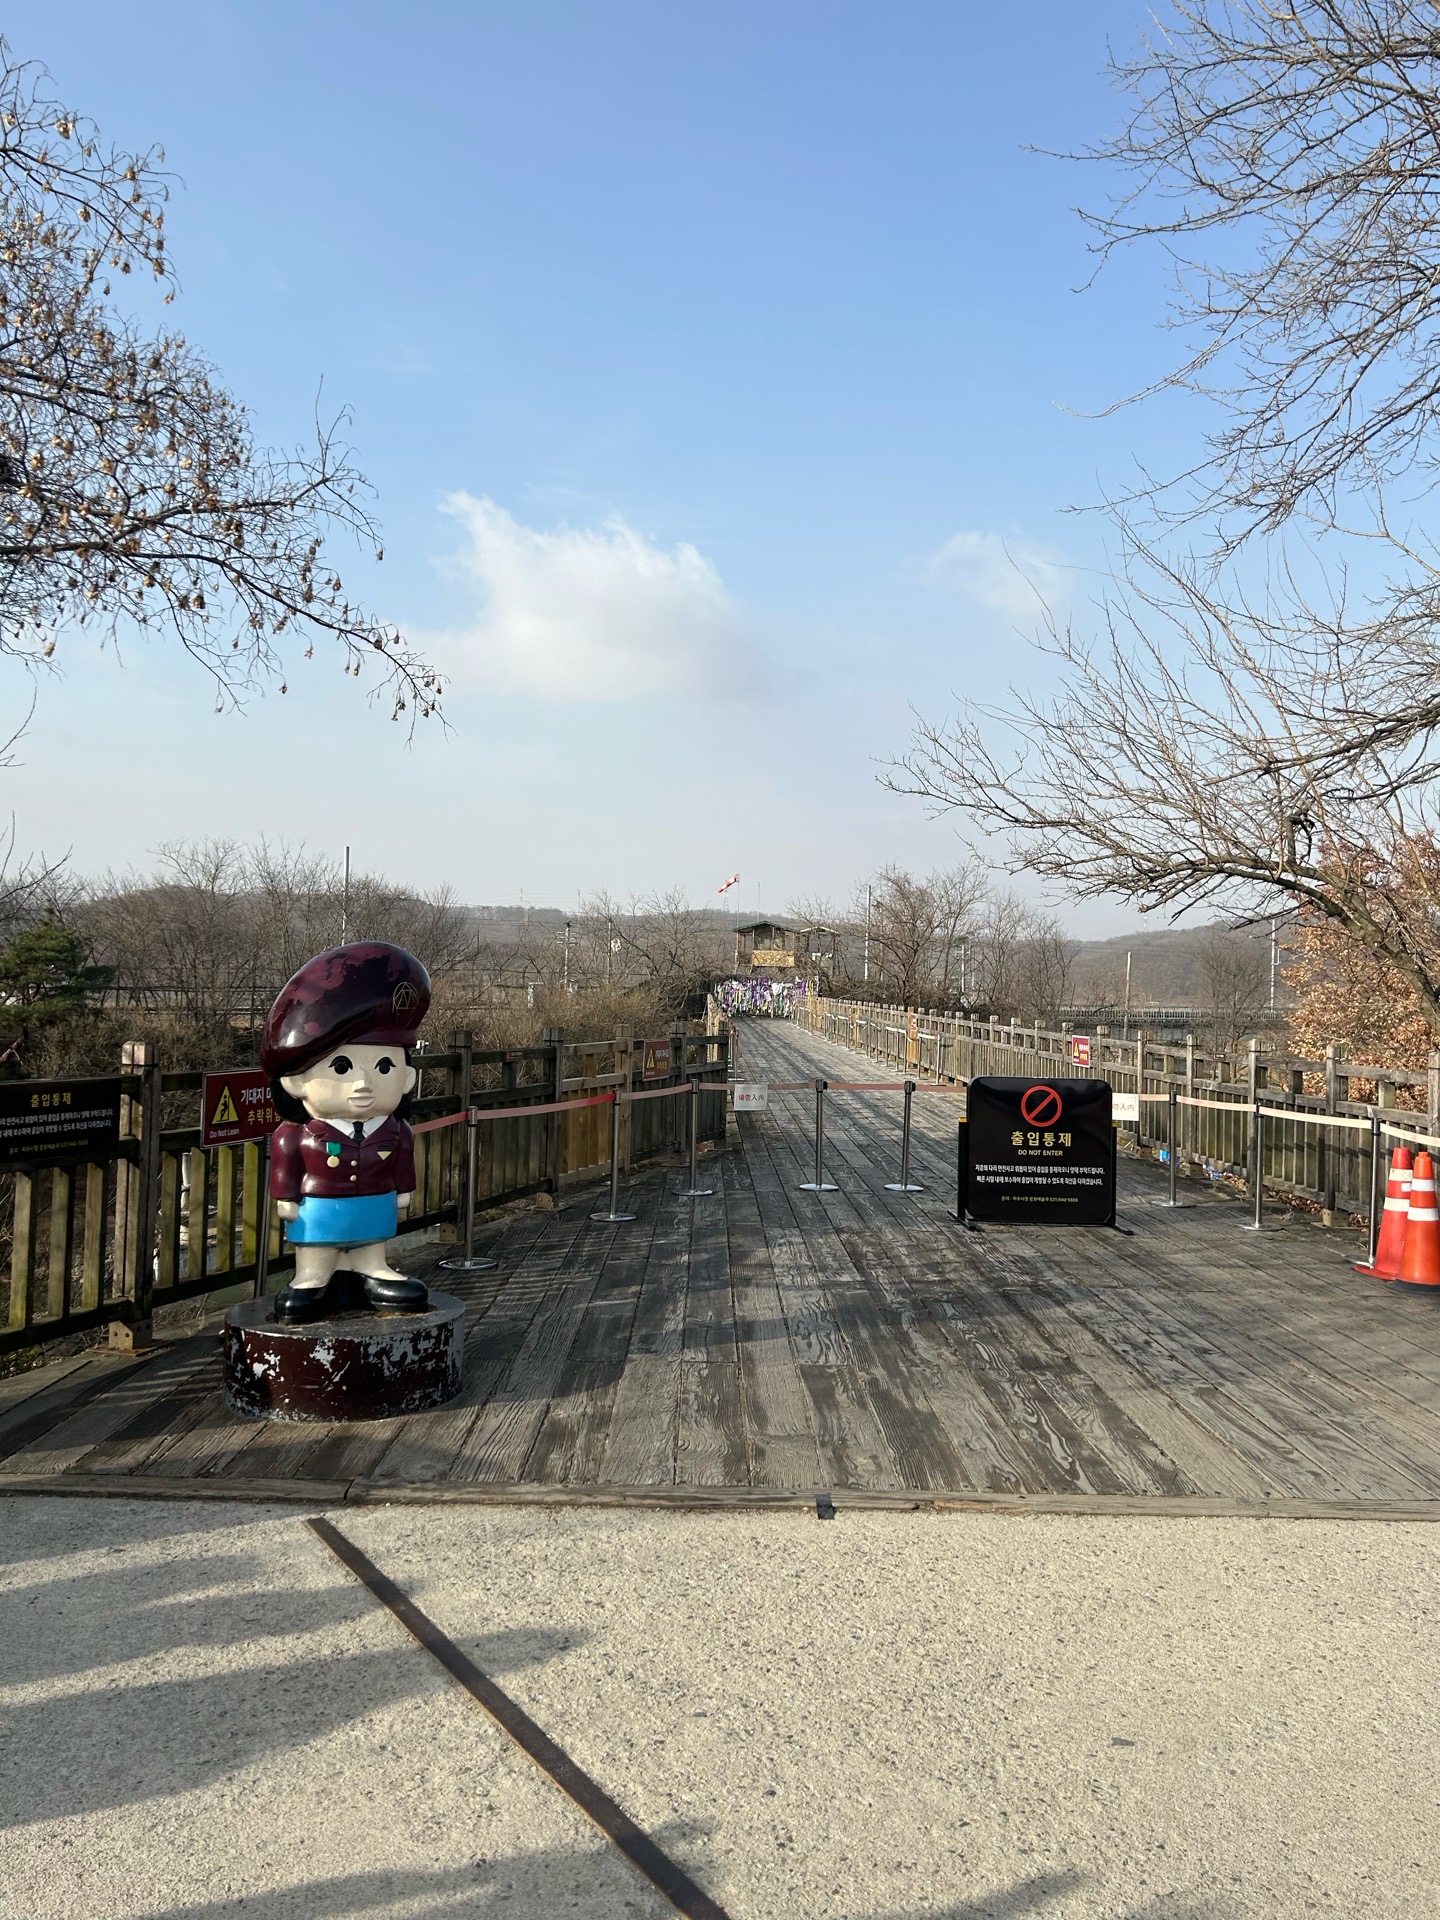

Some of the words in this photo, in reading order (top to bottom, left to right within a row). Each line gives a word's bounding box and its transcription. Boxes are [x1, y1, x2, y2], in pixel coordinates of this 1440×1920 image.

[31, 1092, 71, 1108] 출입통제
[241, 1087, 264, 1105] 기대지
[210, 1130, 217, 1138] Do
[218, 1129, 228, 1138] Not
[228, 1128, 240, 1136] Lean
[1010, 1131, 1072, 1147] 출입통제
[988, 1164, 998, 1172] 다리
[998, 1164, 1014, 1172] 안전사고
